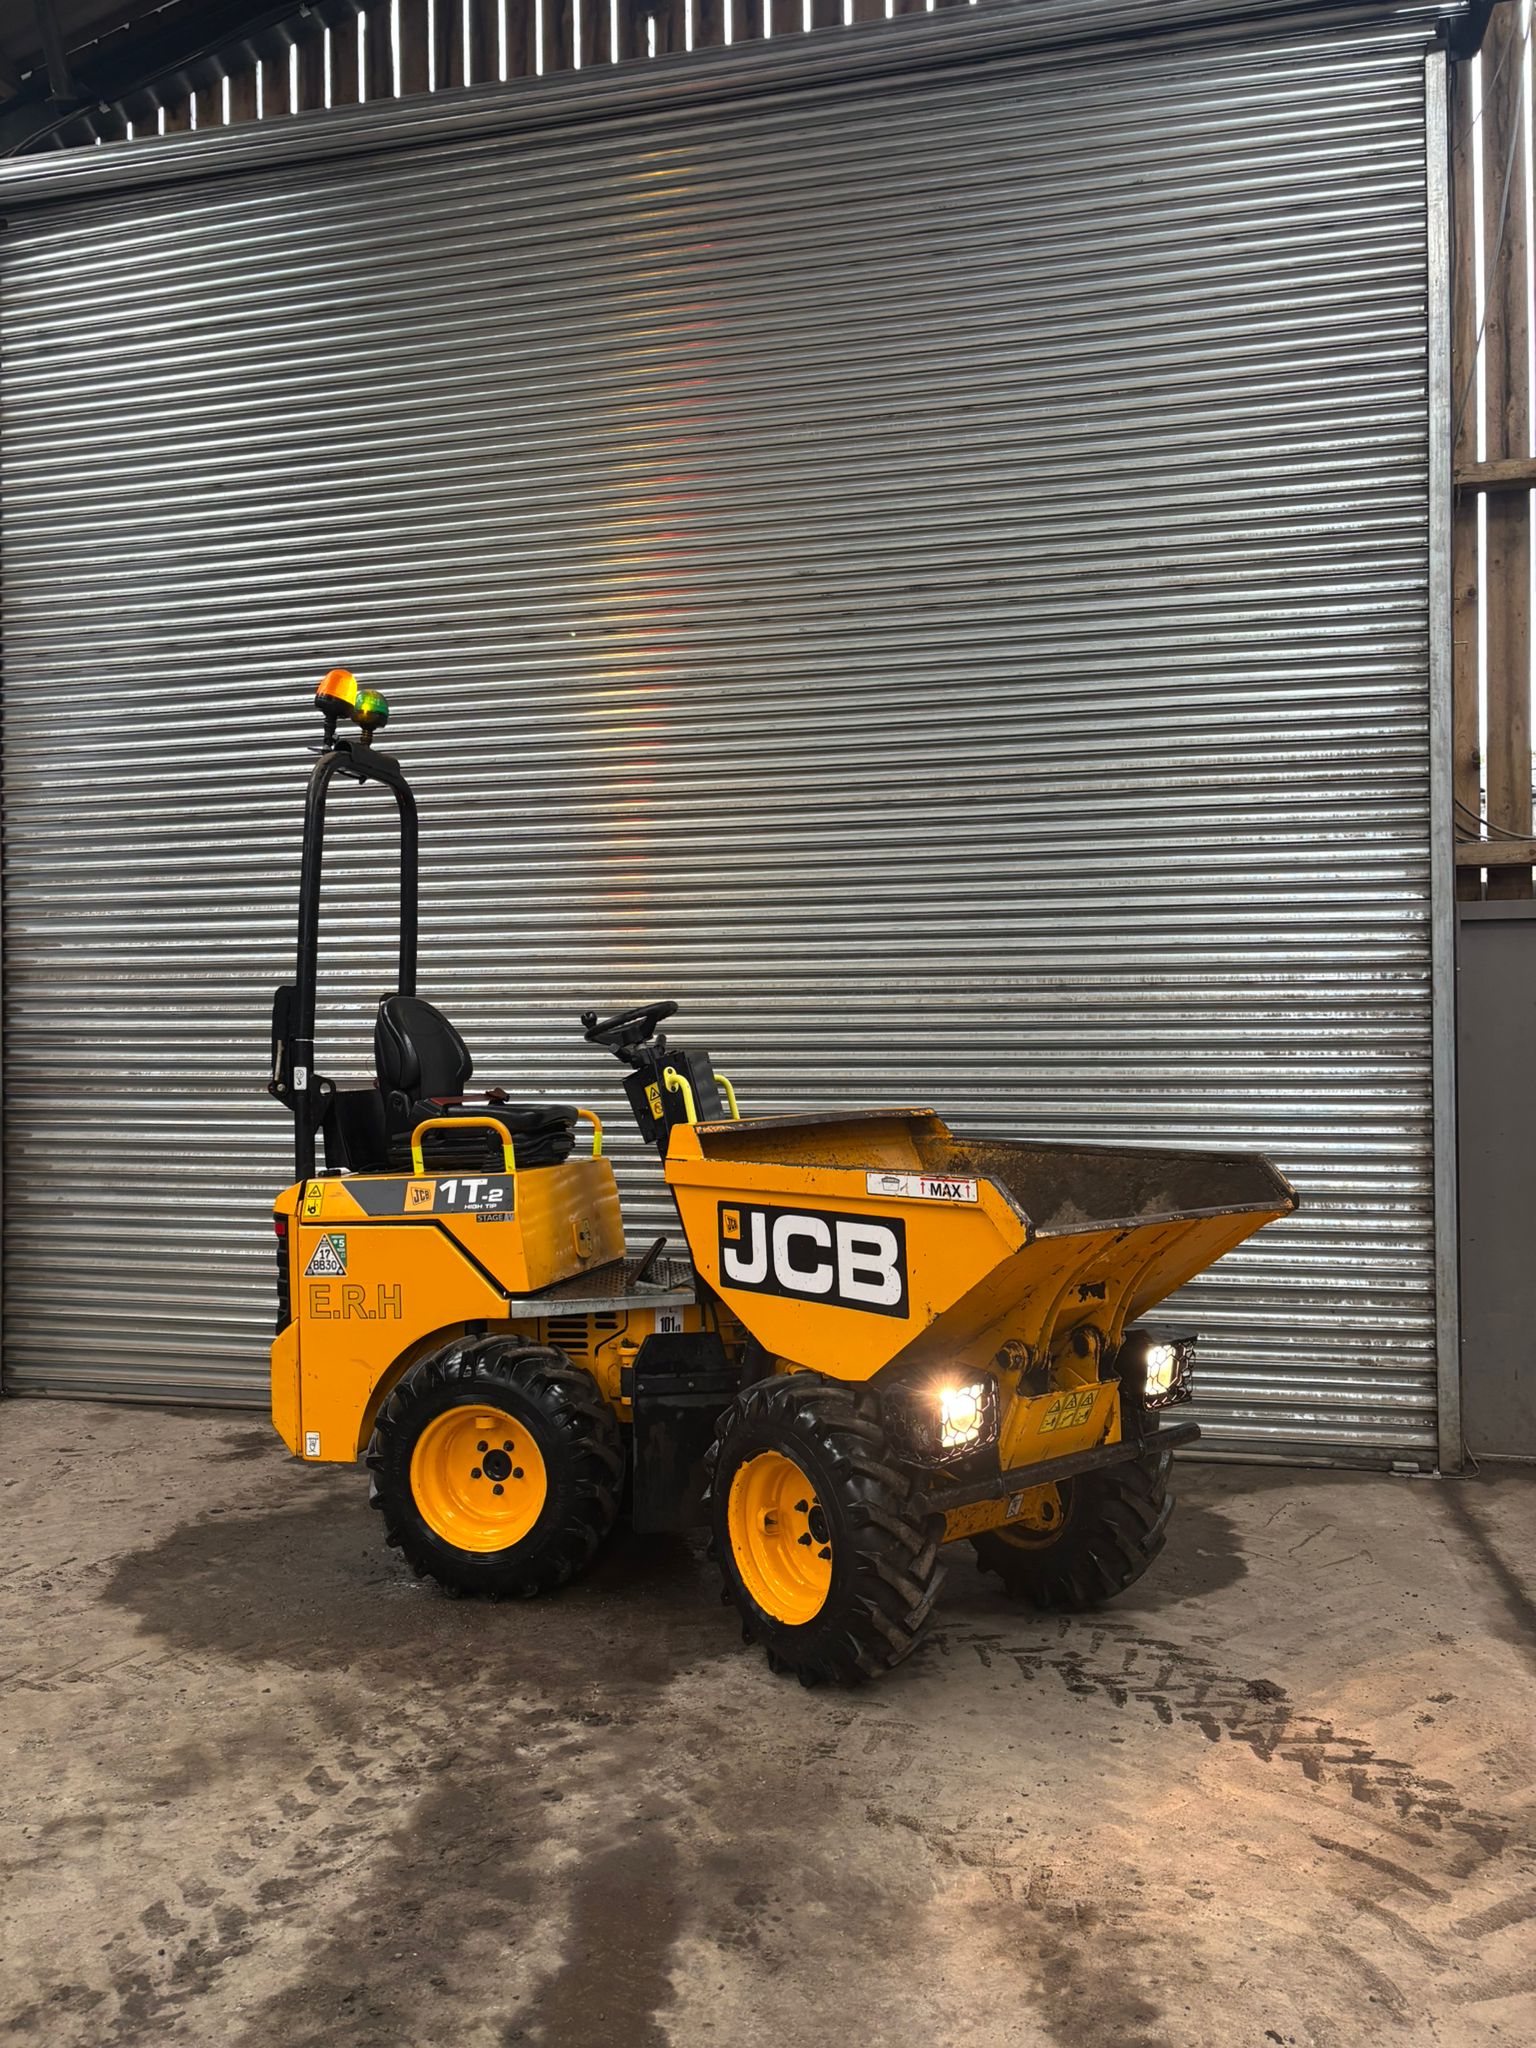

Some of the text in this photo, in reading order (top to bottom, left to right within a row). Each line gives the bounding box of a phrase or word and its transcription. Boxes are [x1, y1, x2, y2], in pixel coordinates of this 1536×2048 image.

[412, 1188, 431, 1203] JCB
[930, 1182, 962, 1198] MAX
[477, 1214, 503, 1222] STAGE
[338, 1239, 345, 1248] 5
[319, 1249, 331, 1260] 17
[723, 1211, 902, 1306] JCB
[309, 1284, 402, 1319] E.R.H
[660, 1316, 675, 1332] 101
